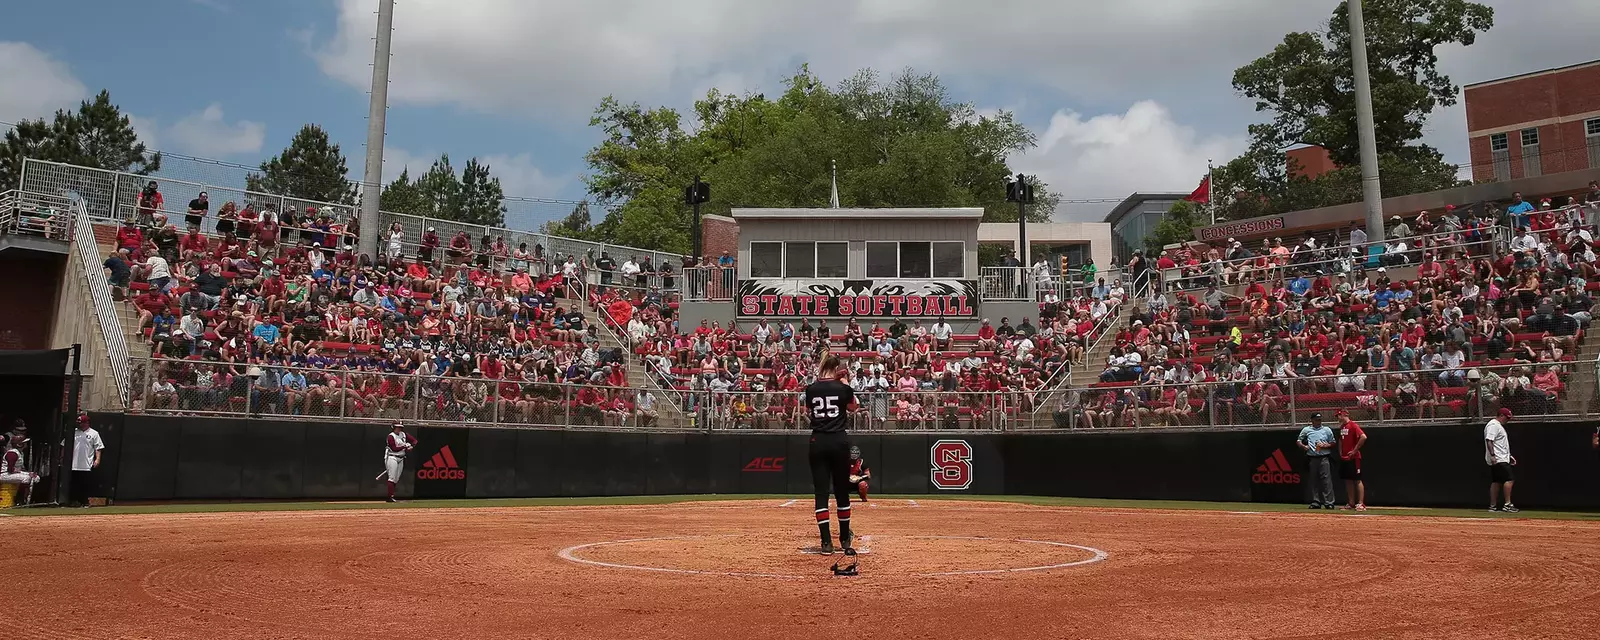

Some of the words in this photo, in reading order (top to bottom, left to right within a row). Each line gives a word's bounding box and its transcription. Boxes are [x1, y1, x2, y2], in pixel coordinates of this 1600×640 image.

[1203, 218, 1283, 240] CONCESSIONS
[742, 294, 829, 315] STATE
[838, 295, 973, 316] SOFTBALL
[812, 395, 840, 418] 25
[743, 456, 786, 470] ACC
[417, 466, 465, 480] adidas
[1252, 471, 1300, 484] adidas
